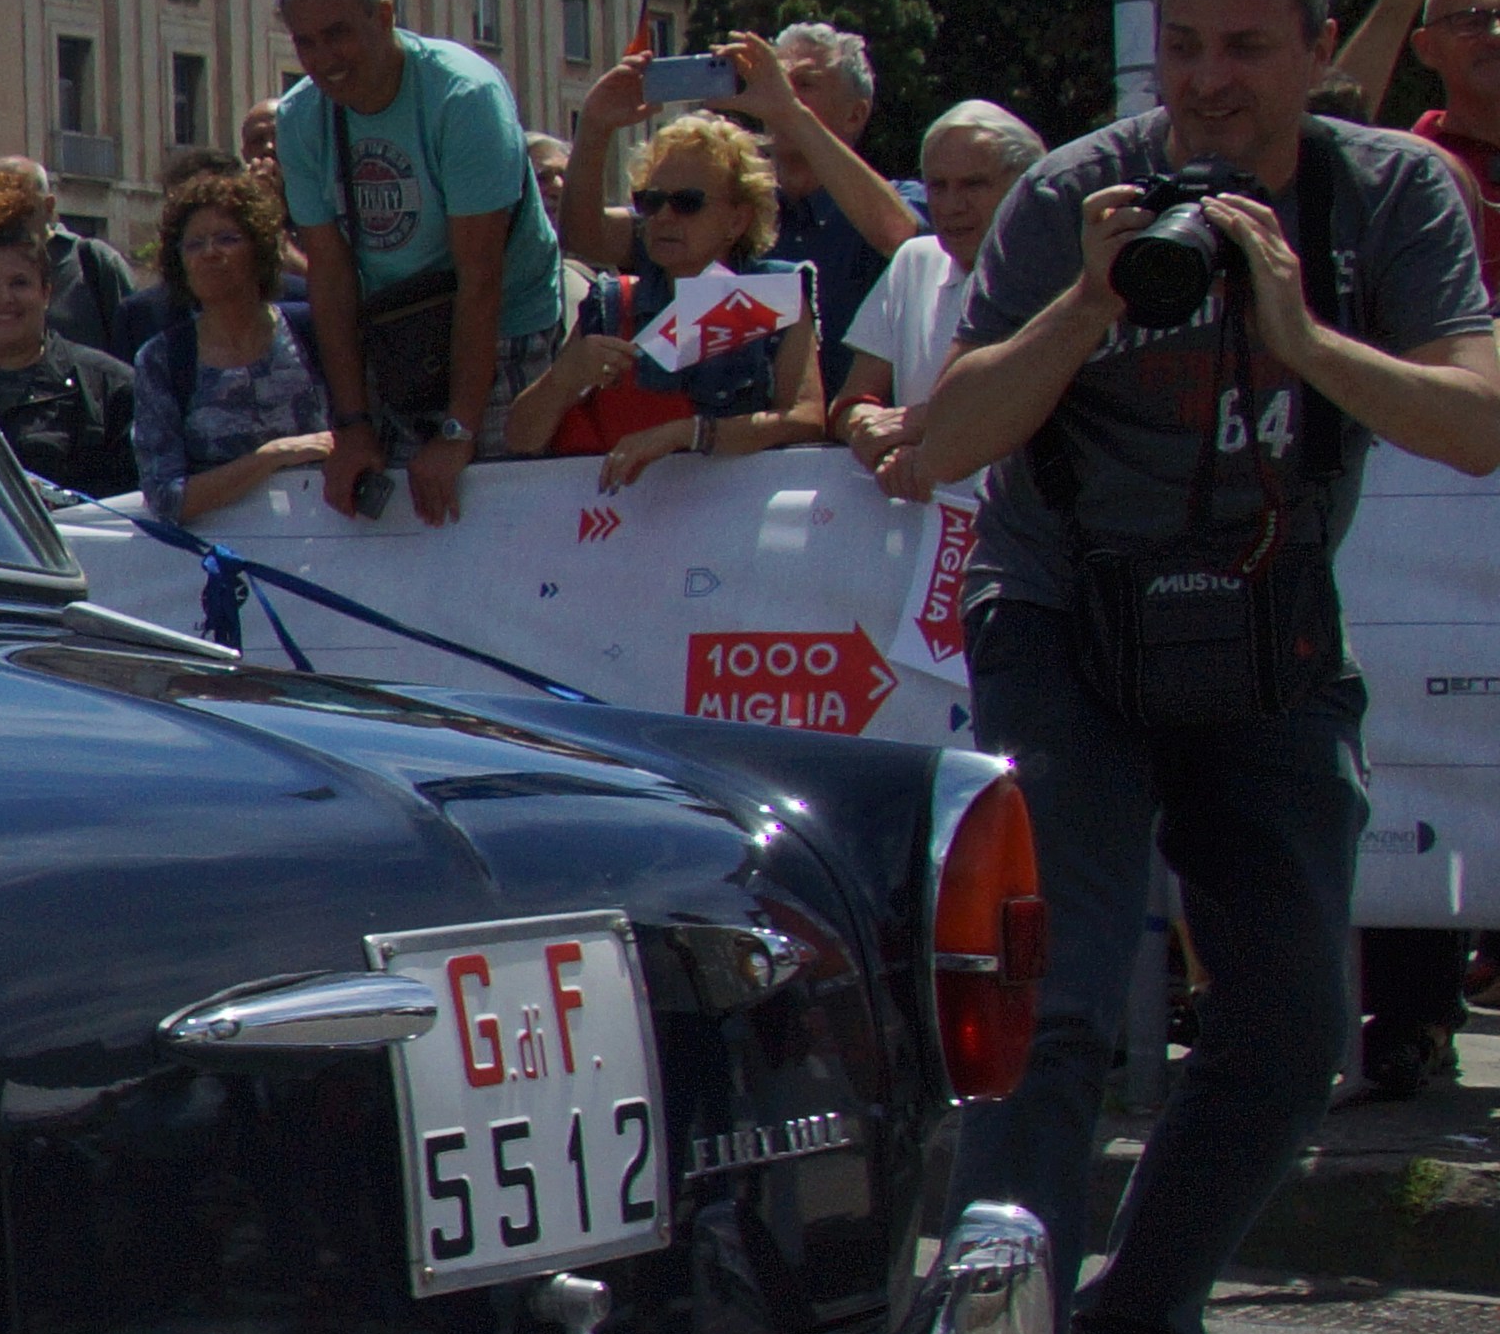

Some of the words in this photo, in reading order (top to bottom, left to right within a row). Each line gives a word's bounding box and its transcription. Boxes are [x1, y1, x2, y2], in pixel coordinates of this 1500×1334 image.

[708, 642, 839, 677] 1000
[697, 691, 846, 727] MIGLIA
[423, 1097, 655, 1261] 5512
